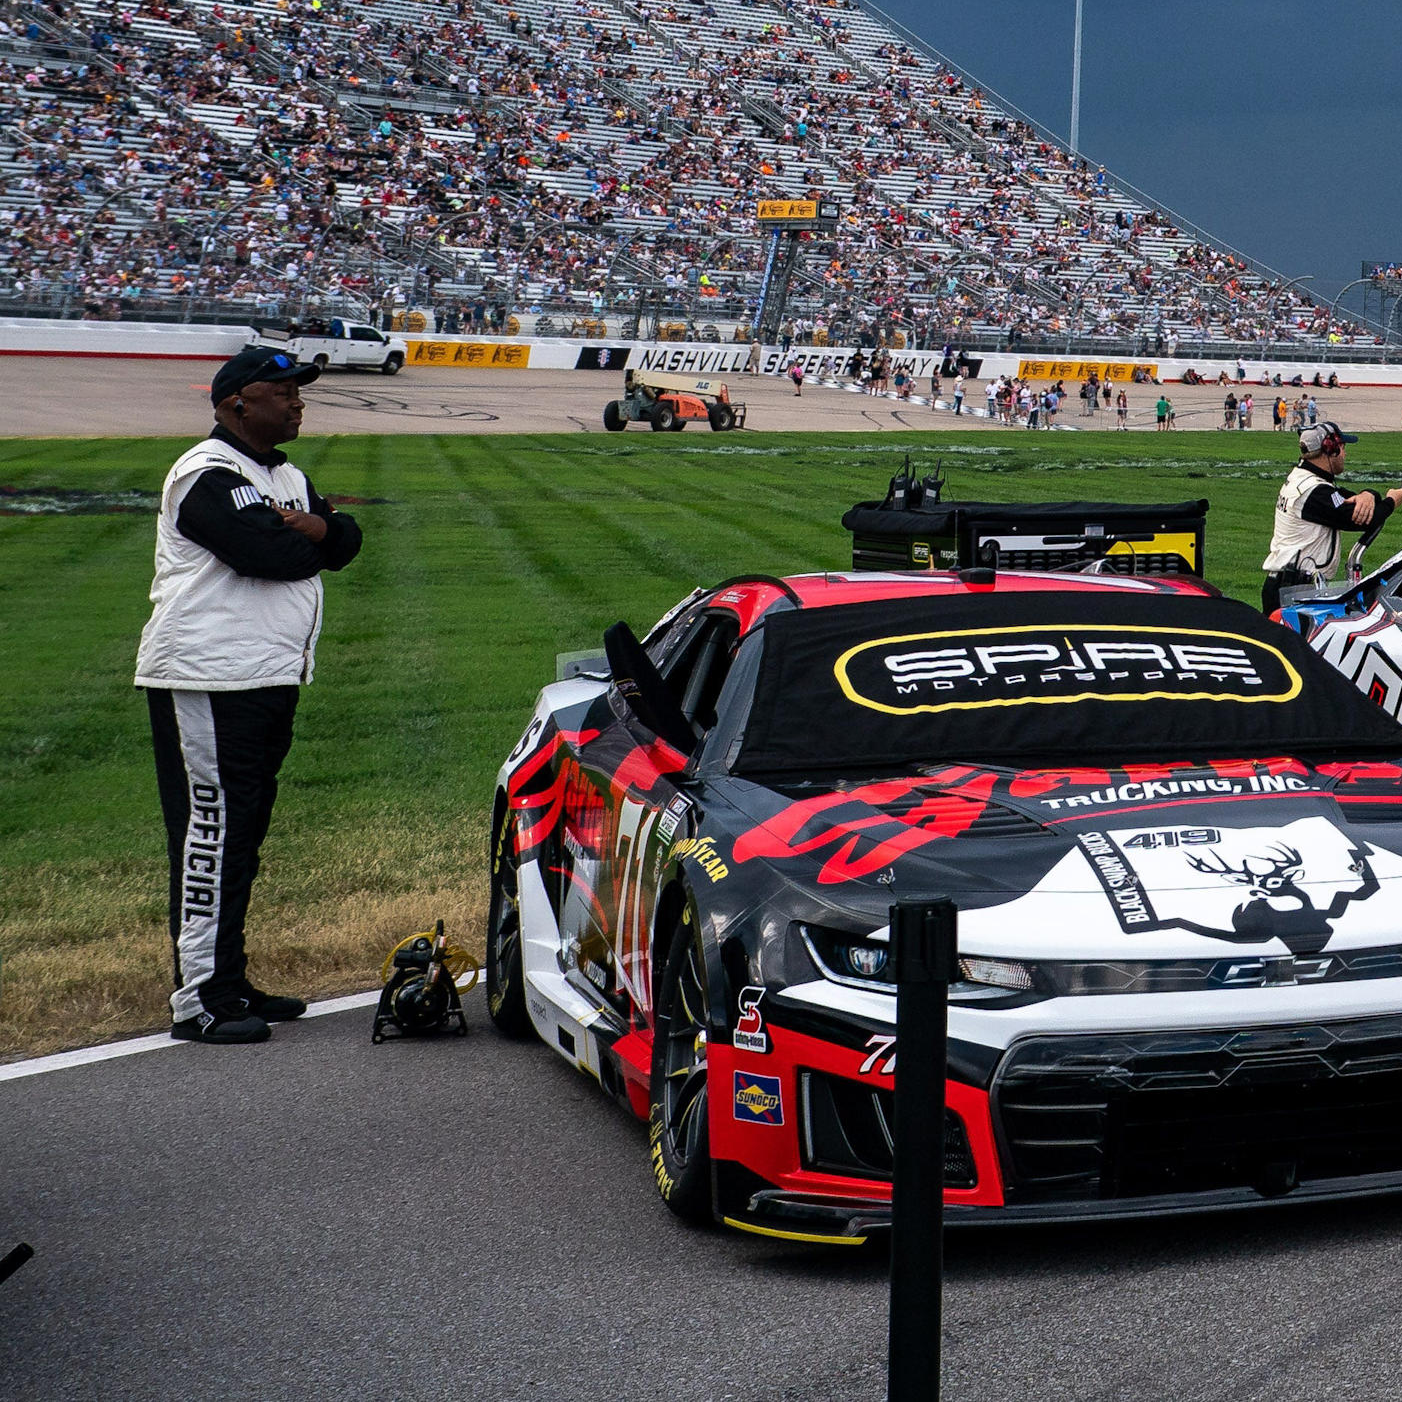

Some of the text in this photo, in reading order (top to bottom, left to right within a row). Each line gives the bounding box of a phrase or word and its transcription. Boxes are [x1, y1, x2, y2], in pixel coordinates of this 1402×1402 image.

[696, 381, 709, 389] JLG
[896, 669, 1263, 695] MOTORSPORTS
[1041, 774, 1321, 810] TRUCKING, INC.
[185, 783, 220, 923] OFFICIAL
[1122, 828, 1222, 850] 419
[668, 836, 730, 884] GOODYEAR
[1113, 886, 1151, 924] BLACK
[737, 1090, 777, 1109] SUNOCO
